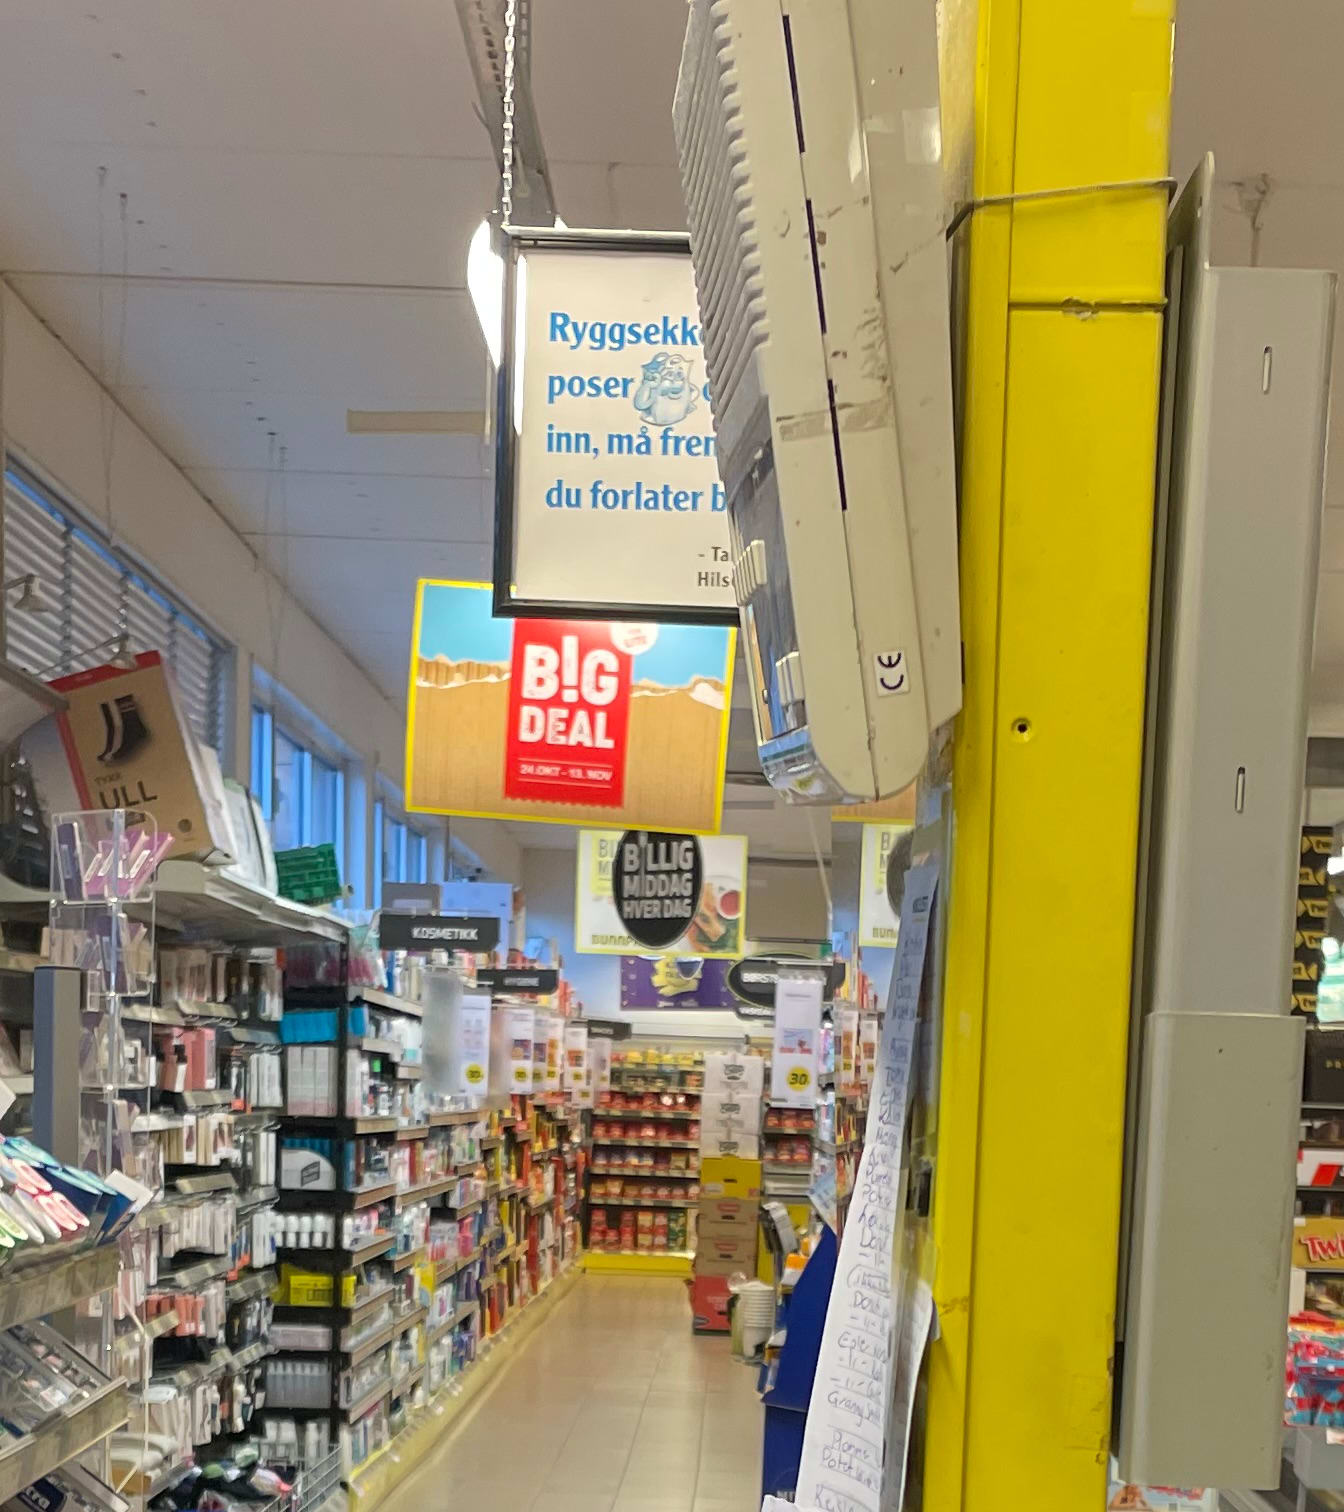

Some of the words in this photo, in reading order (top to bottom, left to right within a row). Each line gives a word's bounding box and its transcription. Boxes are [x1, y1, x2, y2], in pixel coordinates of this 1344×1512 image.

[547, 373, 635, 404] poser
[546, 424, 600, 459] inn,
[607, 425, 652, 456] må
[545, 479, 582, 509] du
[590, 480, 704, 511] forlater
[697, 571, 735, 588] Hils
[518, 704, 616, 749] DEAL
[99, 781, 158, 810] ULL
[623, 872, 693, 899] MIDDAG
[623, 899, 661, 919] HVER
[663, 898, 692, 919] DAG
[411, 927, 479, 941] KOSMETIKK
[591, 934, 638, 945] BUNNP
